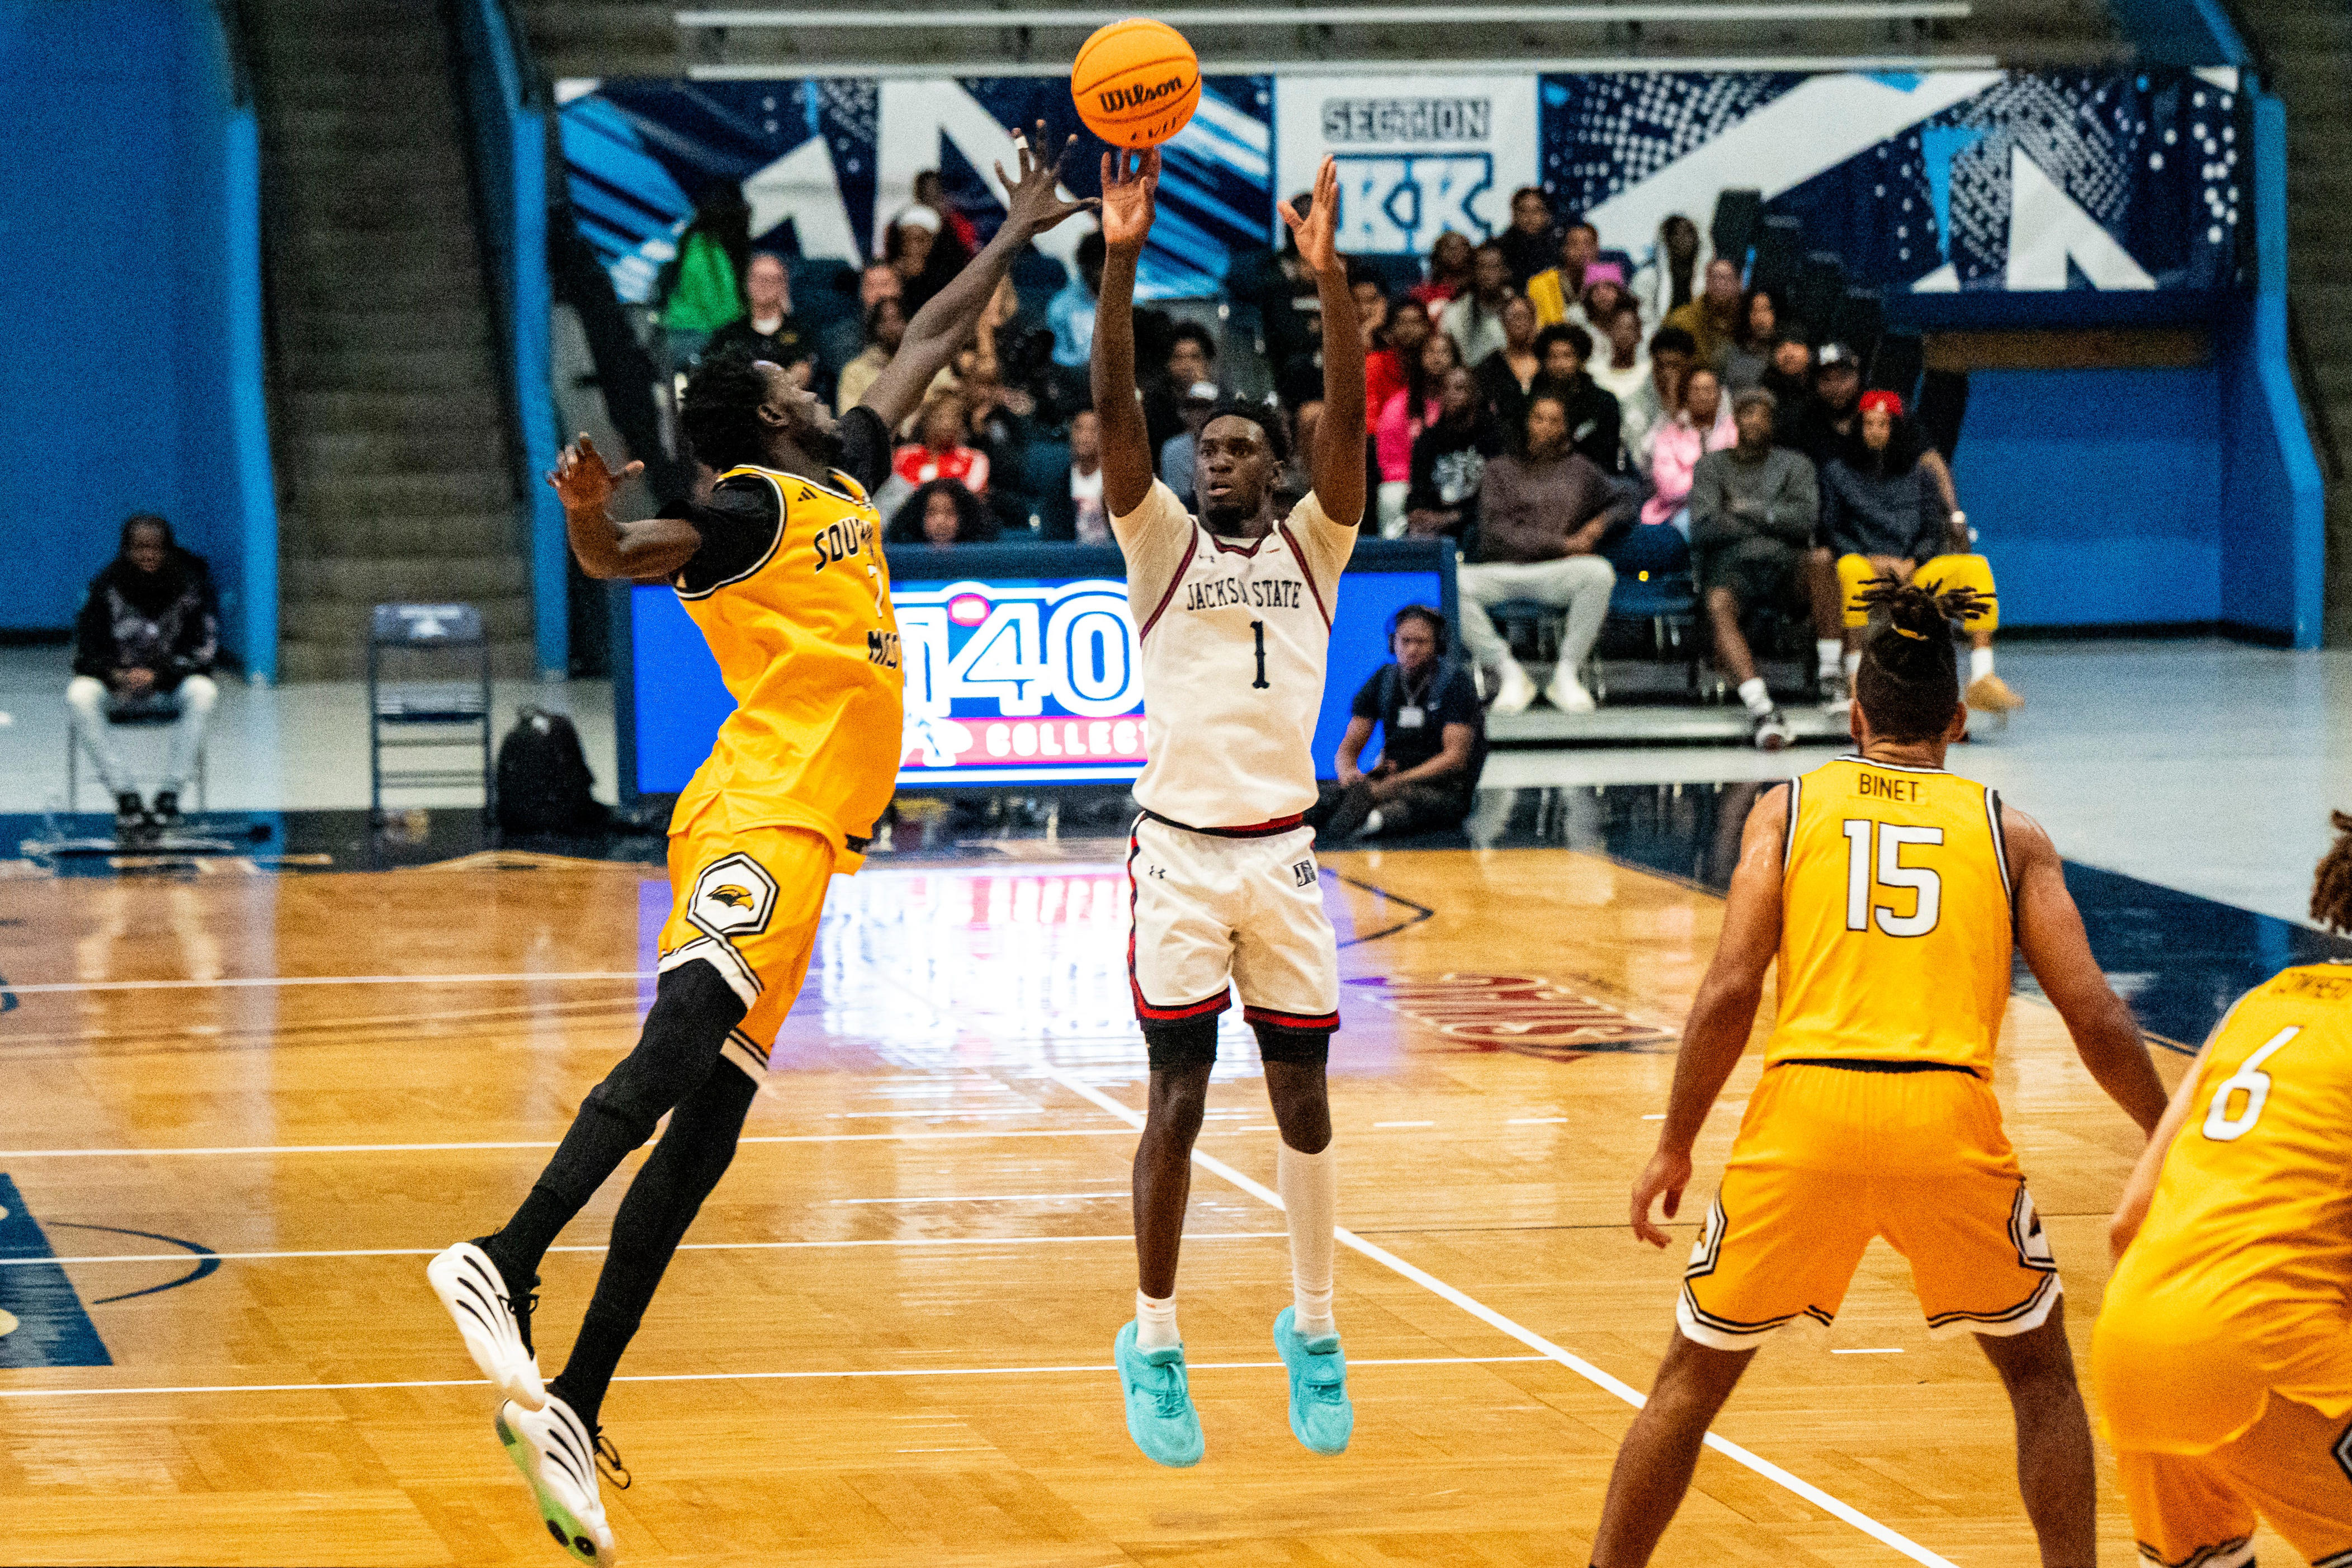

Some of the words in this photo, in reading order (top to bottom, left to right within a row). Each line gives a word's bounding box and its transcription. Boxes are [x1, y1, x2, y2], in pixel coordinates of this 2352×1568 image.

[1098, 76, 1183, 114] Wilson
[1321, 96, 1491, 141] SECTION
[1334, 151, 1493, 254] KK
[1251, 579, 1302, 608] STATE
[1250, 620, 1271, 689] 1
[986, 720, 1146, 757] COLLEC
[1859, 773, 1919, 802] BINET
[1843, 818, 1944, 938] 15
[2202, 1025, 2304, 1143] 6
